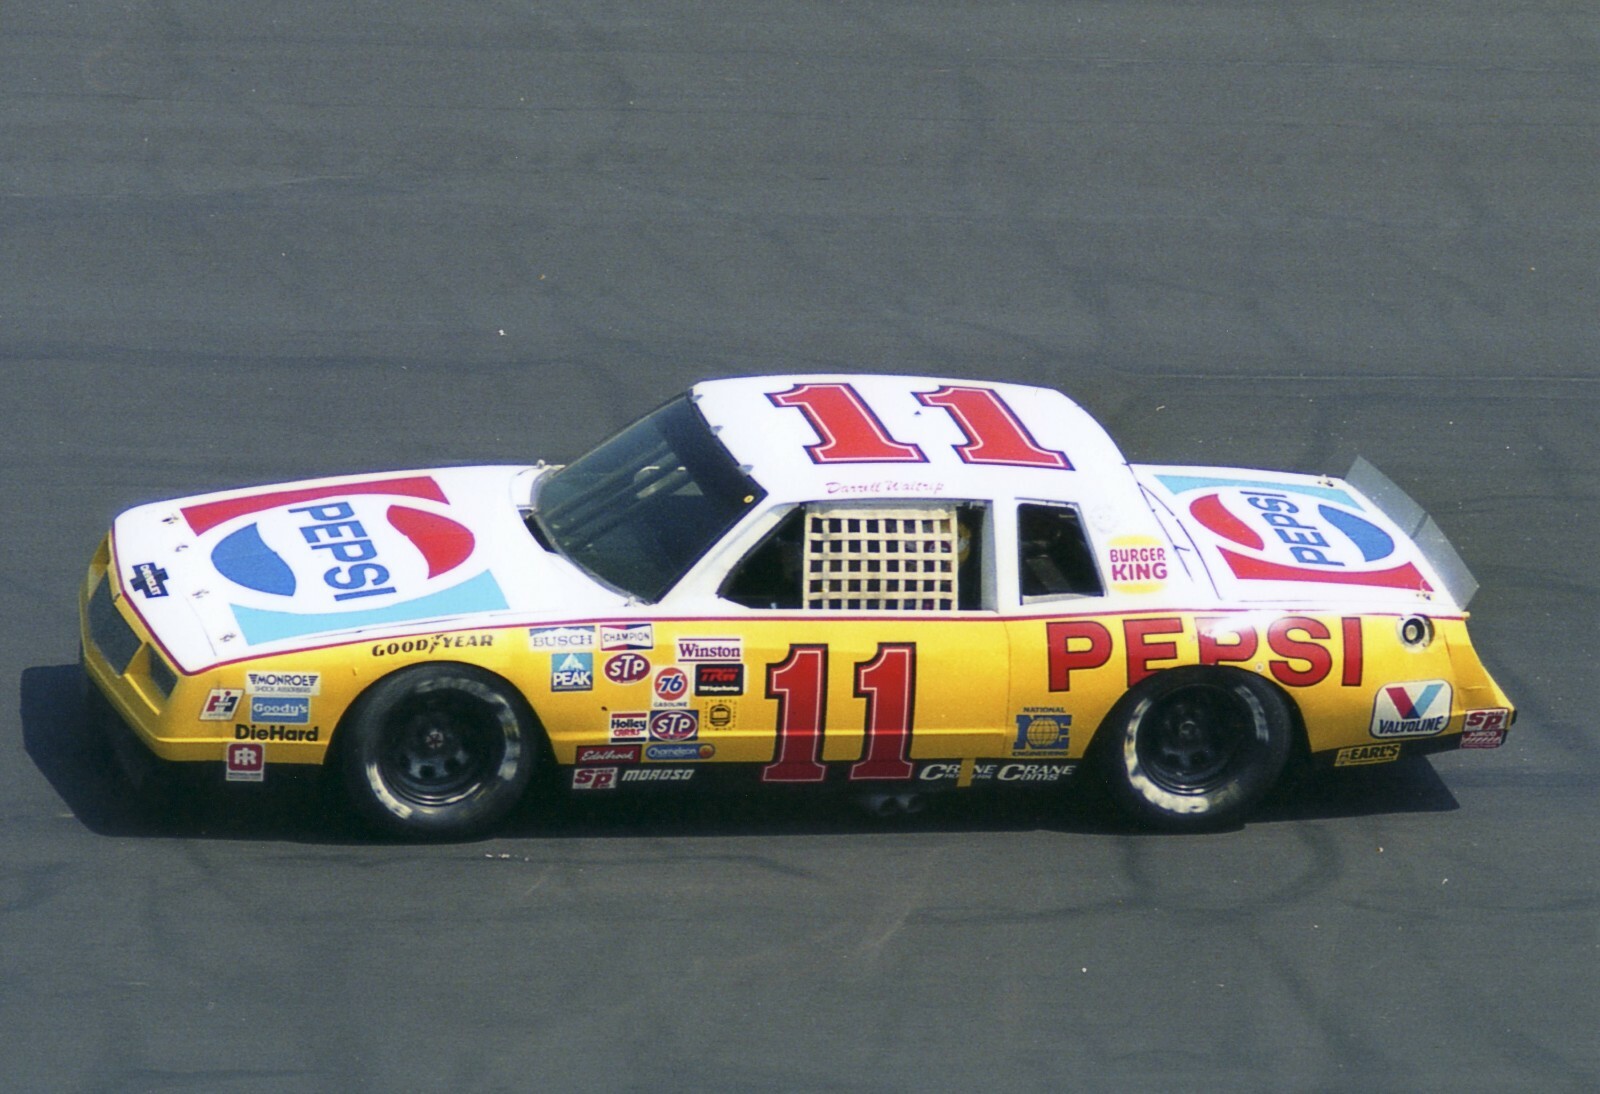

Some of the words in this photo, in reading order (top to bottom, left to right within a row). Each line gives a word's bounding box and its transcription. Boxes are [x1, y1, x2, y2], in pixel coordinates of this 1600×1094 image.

[763, 383, 1076, 471] 11
[1240, 490, 1345, 567] PEPSI
[289, 501, 397, 601] PEPSI
[1109, 547, 1167, 562] BURGER
[1112, 562, 1168, 581] KING
[533, 634, 593, 647] BUSCH
[603, 631, 650, 642] CHAMPION
[679, 643, 741, 657] Winston
[1045, 616, 1363, 693] PEPSI
[609, 654, 645, 679] STP
[257, 674, 309, 687] MONROE
[553, 671, 591, 686] PEAK
[657, 673, 684, 694] 76
[253, 703, 309, 717] Goody's
[762, 642, 917, 783] 11
[235, 724, 319, 742] DieHard
[656, 714, 691, 735] STP
[1378, 716, 1445, 735] VALVOLINE
[622, 769, 695, 781] MOROSO
[919, 763, 998, 781] CRNE
